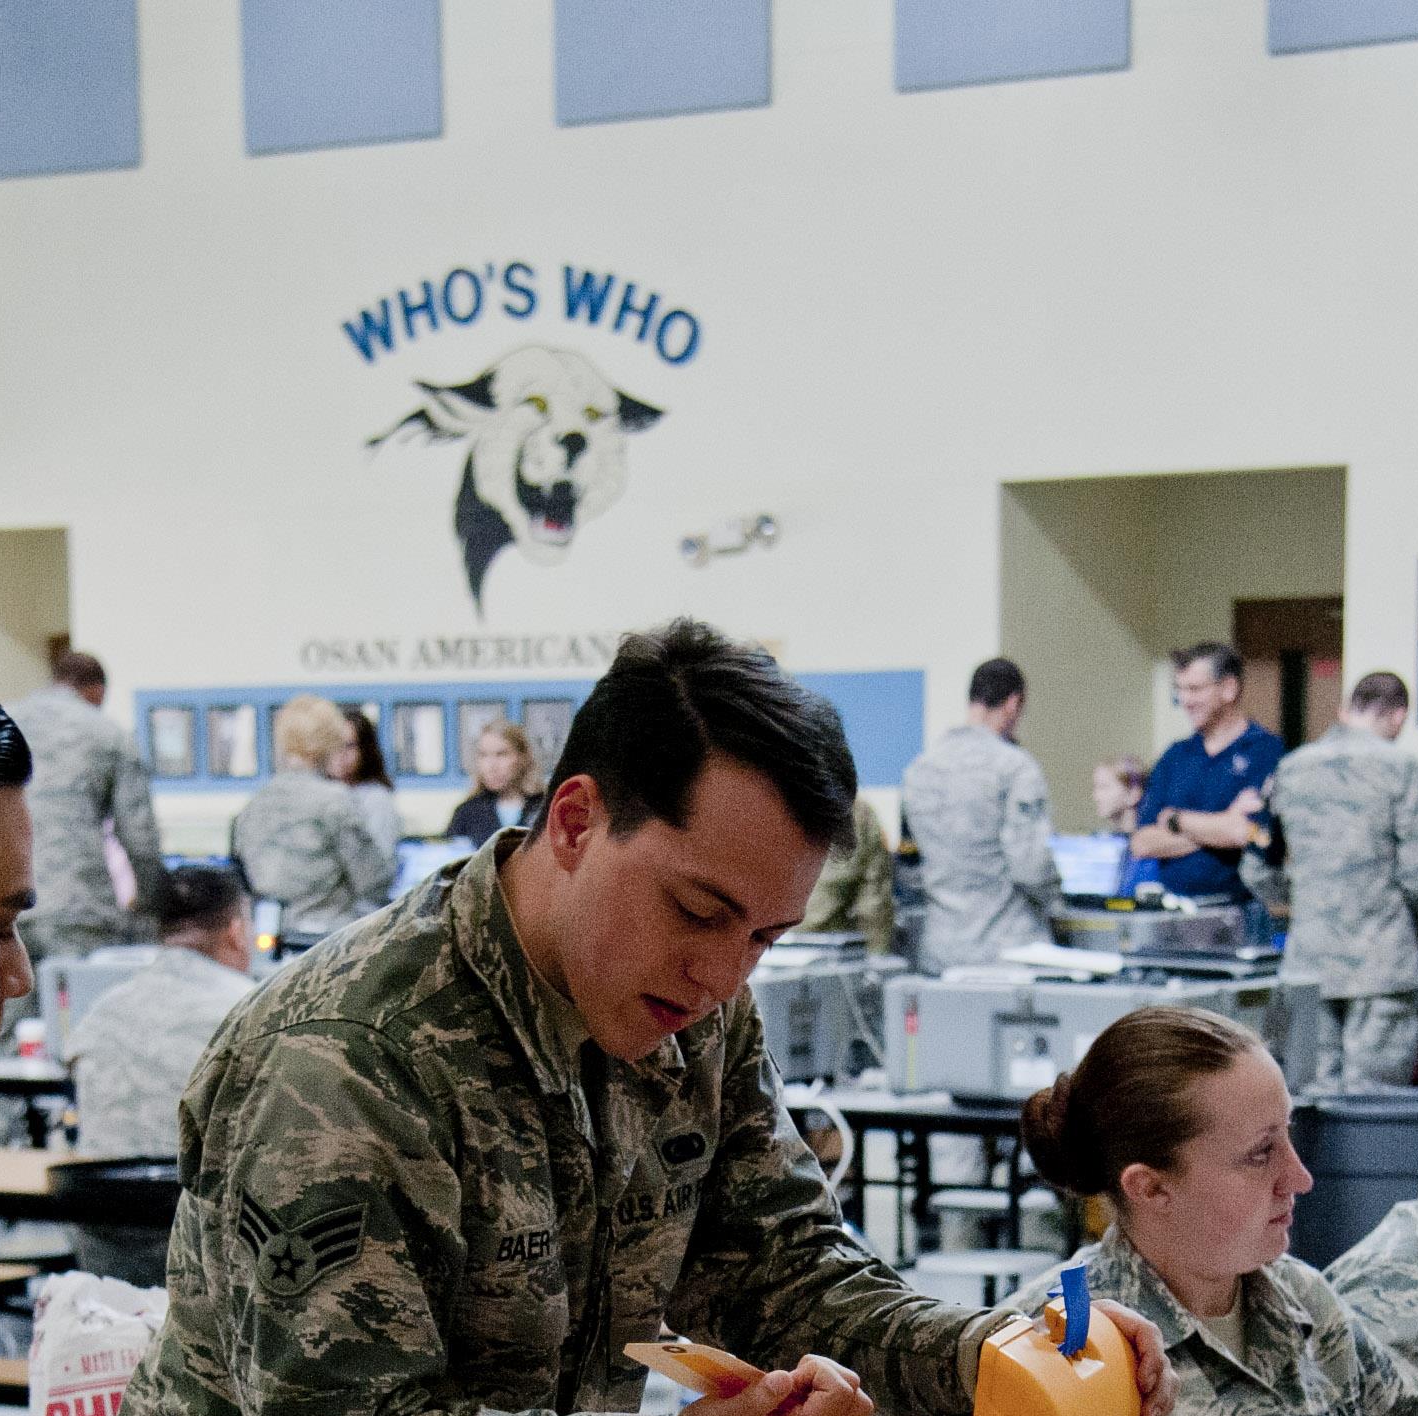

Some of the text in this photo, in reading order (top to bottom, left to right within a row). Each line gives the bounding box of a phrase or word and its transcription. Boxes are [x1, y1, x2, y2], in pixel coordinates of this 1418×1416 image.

[342, 261, 703, 367] WHO'S WHO
[300, 637, 400, 672] OSAN
[496, 1230, 551, 1263] BAER
